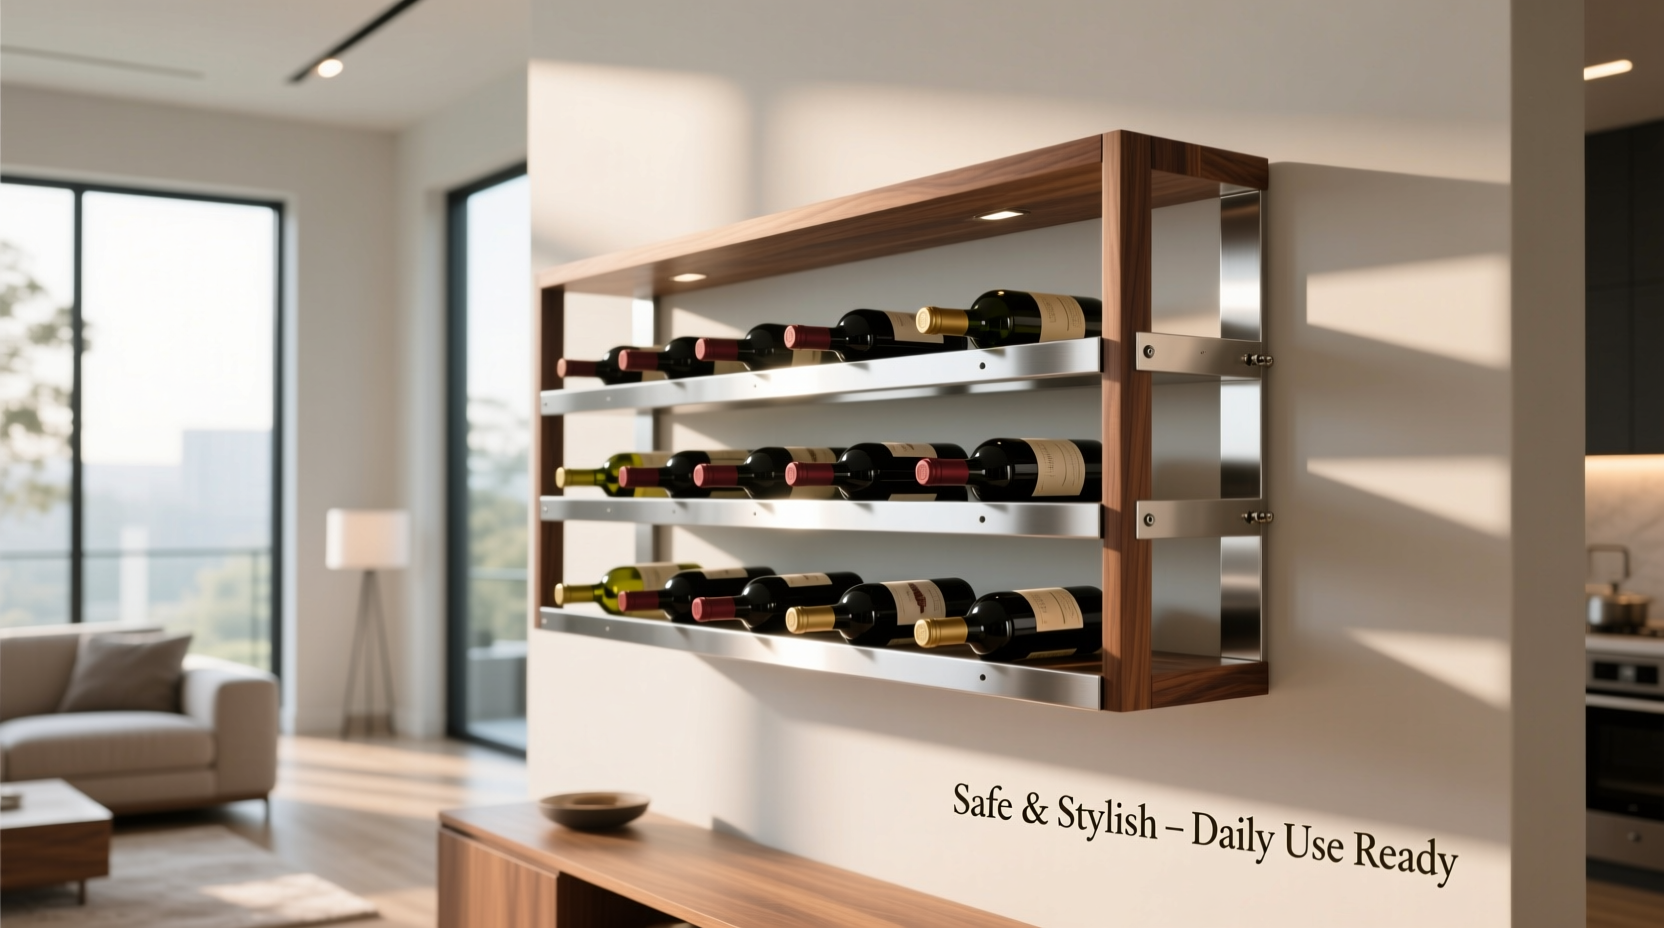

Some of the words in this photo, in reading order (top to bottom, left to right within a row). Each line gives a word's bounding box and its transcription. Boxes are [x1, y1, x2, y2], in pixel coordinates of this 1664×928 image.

[953, 782, 1013, 821] Safe
[1022, 791, 1049, 825] &
[1057, 794, 1158, 842] Stylish
[1191, 811, 1276, 865] Daily
[1283, 822, 1344, 863] Use
[1353, 831, 1459, 889] Ready
